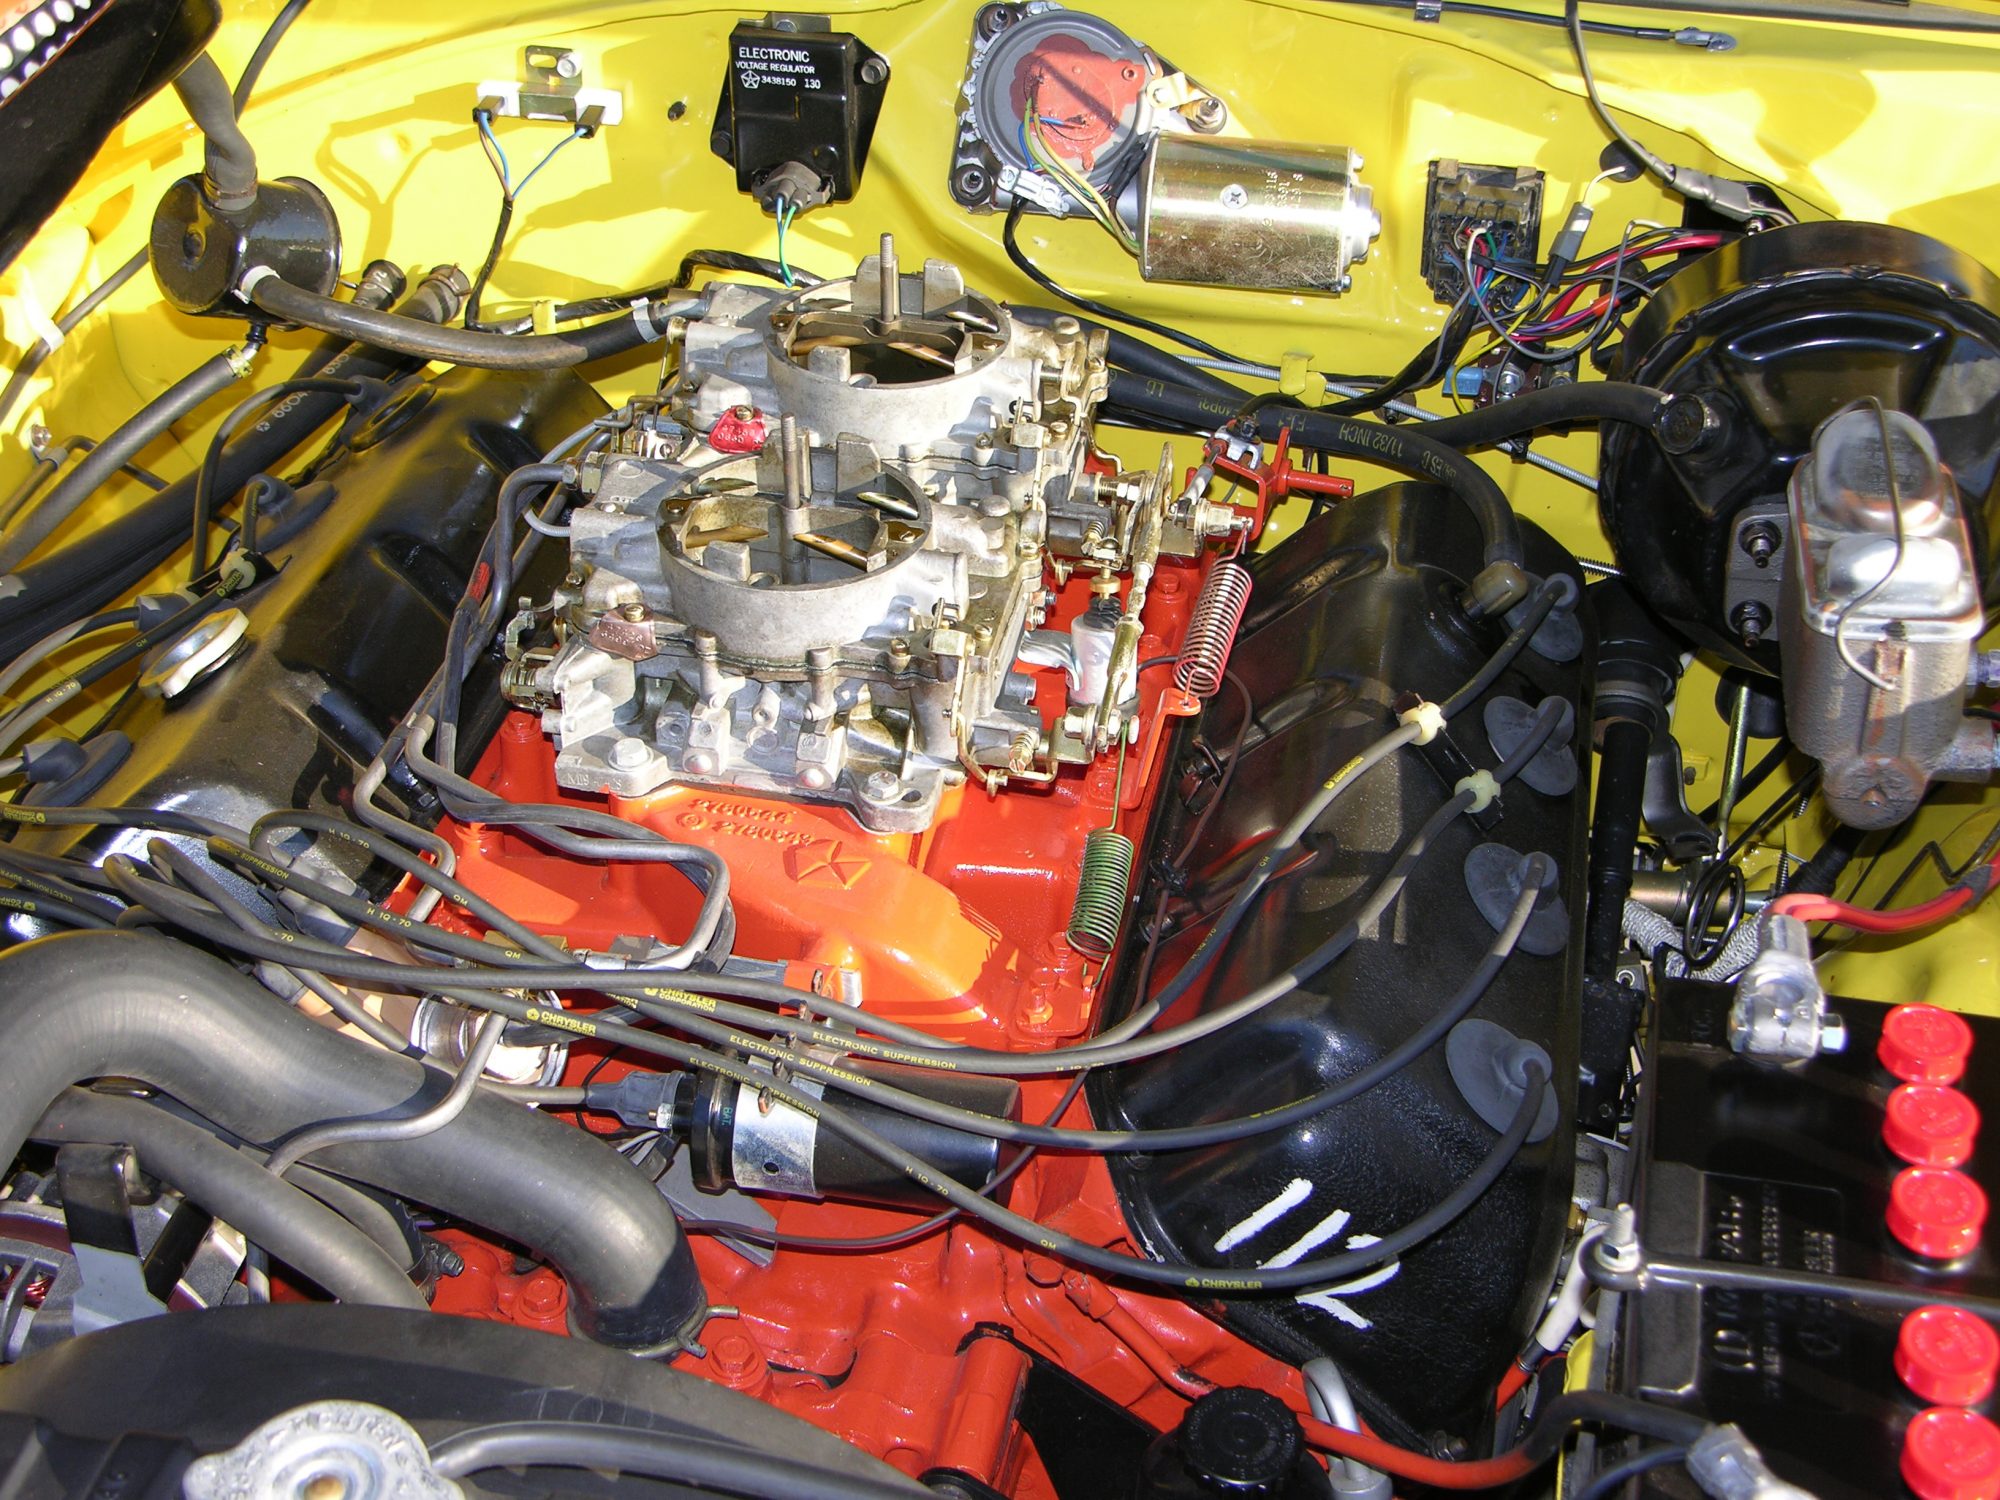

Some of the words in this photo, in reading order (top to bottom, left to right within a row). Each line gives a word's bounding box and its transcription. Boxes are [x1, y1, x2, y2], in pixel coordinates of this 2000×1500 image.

[739, 46, 810, 63] ELECTRONIC
[735, 61, 769, 71] VOLTAGE
[769, 62, 815, 74] REGULATOR
[760, 75, 797, 87] 3438150
[804, 78, 821, 90] 130
[1338, 422, 1370, 447] INCH
[1373, 427, 1402, 458] 11/32
[240, 852, 289, 880] SUPPRESSION
[453, 894, 469, 906] QM
[505, 949, 521, 960] QM
[659, 993, 716, 1013] CORPORATION
[541, 1010, 597, 1034] CHRYSLER
[729, 1034, 795, 1062] ELECTRONIC
[799, 1057, 872, 1087] SUPPRESSION
[812, 1031, 878, 1055] ELECTRONIC
[883, 1049, 957, 1070] SUPPRESSION
[689, 1057, 751, 1083] ELECTRONIC
[755, 1081, 821, 1118] SPPRESSION
[1040, 1239, 1057, 1250] QM
[1201, 1278, 1263, 1289] CHRYSLER
